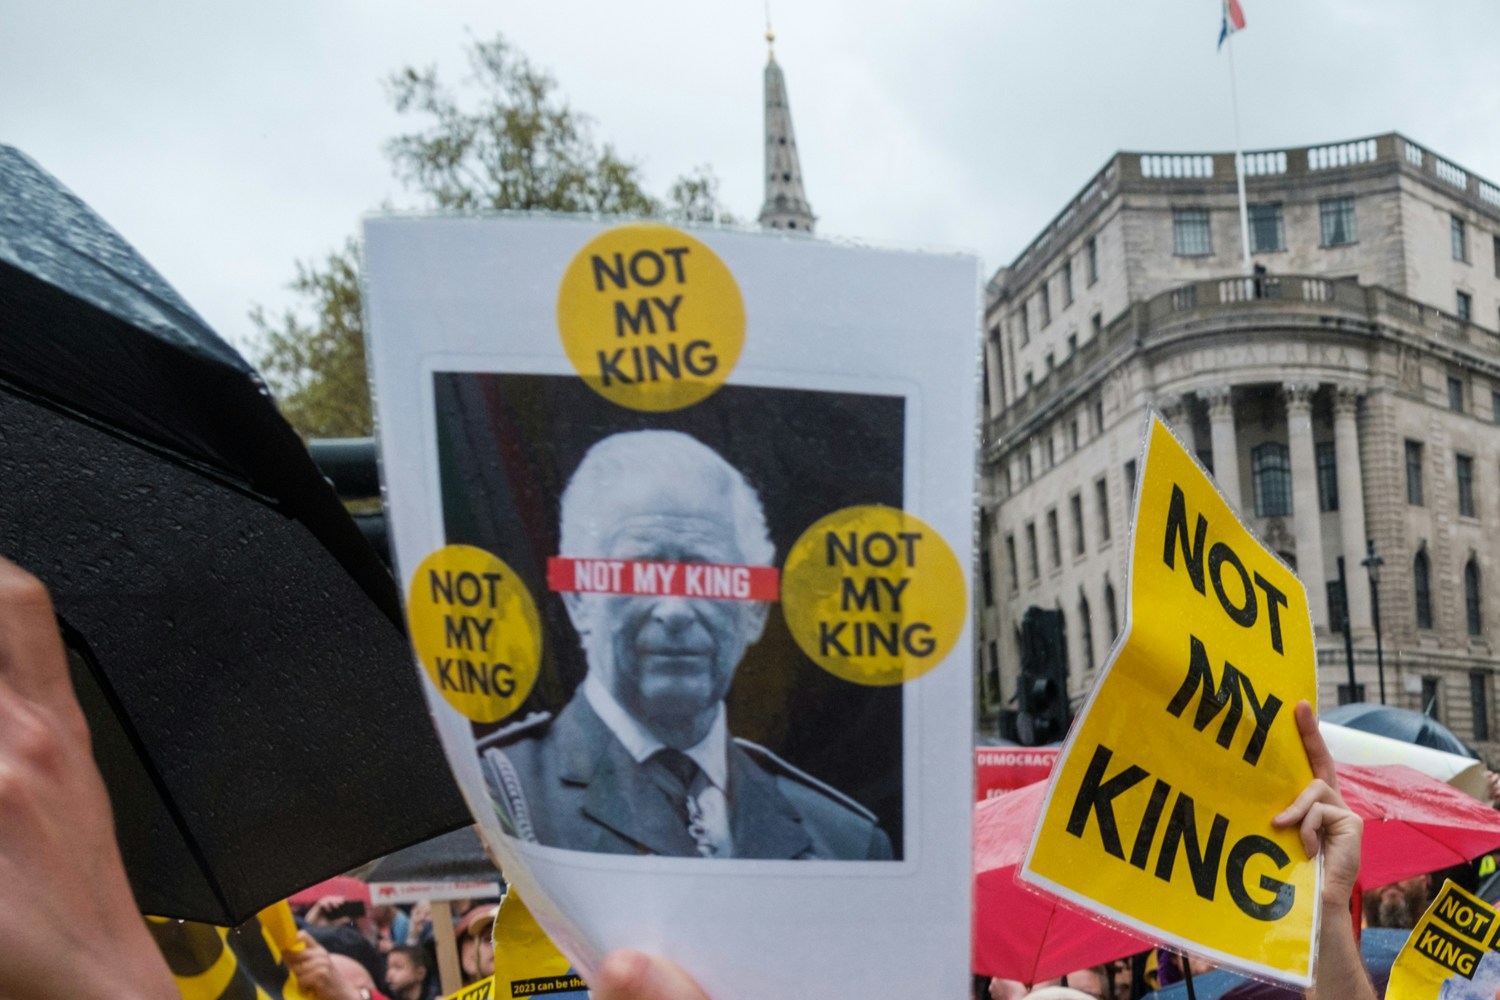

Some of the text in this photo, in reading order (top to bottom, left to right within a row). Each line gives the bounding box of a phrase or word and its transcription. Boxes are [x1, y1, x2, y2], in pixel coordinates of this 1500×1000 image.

[591, 247, 689, 291] NOT
[614, 295, 682, 337] MY
[598, 340, 718, 386] KING
[826, 531, 921, 569] NOT
[1163, 483, 1288, 655] NOT
[430, 569, 502, 608] NOT
[574, 560, 750, 598] NOT MY KING
[841, 578, 910, 613] MY
[445, 615, 494, 652] MY
[819, 622, 937, 659] KING
[436, 657, 516, 697] KING
[1167, 635, 1283, 767] MY
[1066, 744, 1296, 922] KING
[1439, 896, 1490, 934] NOT
[1419, 930, 1476, 976] KING
[513, 977, 586, 994] 2023 can be the
